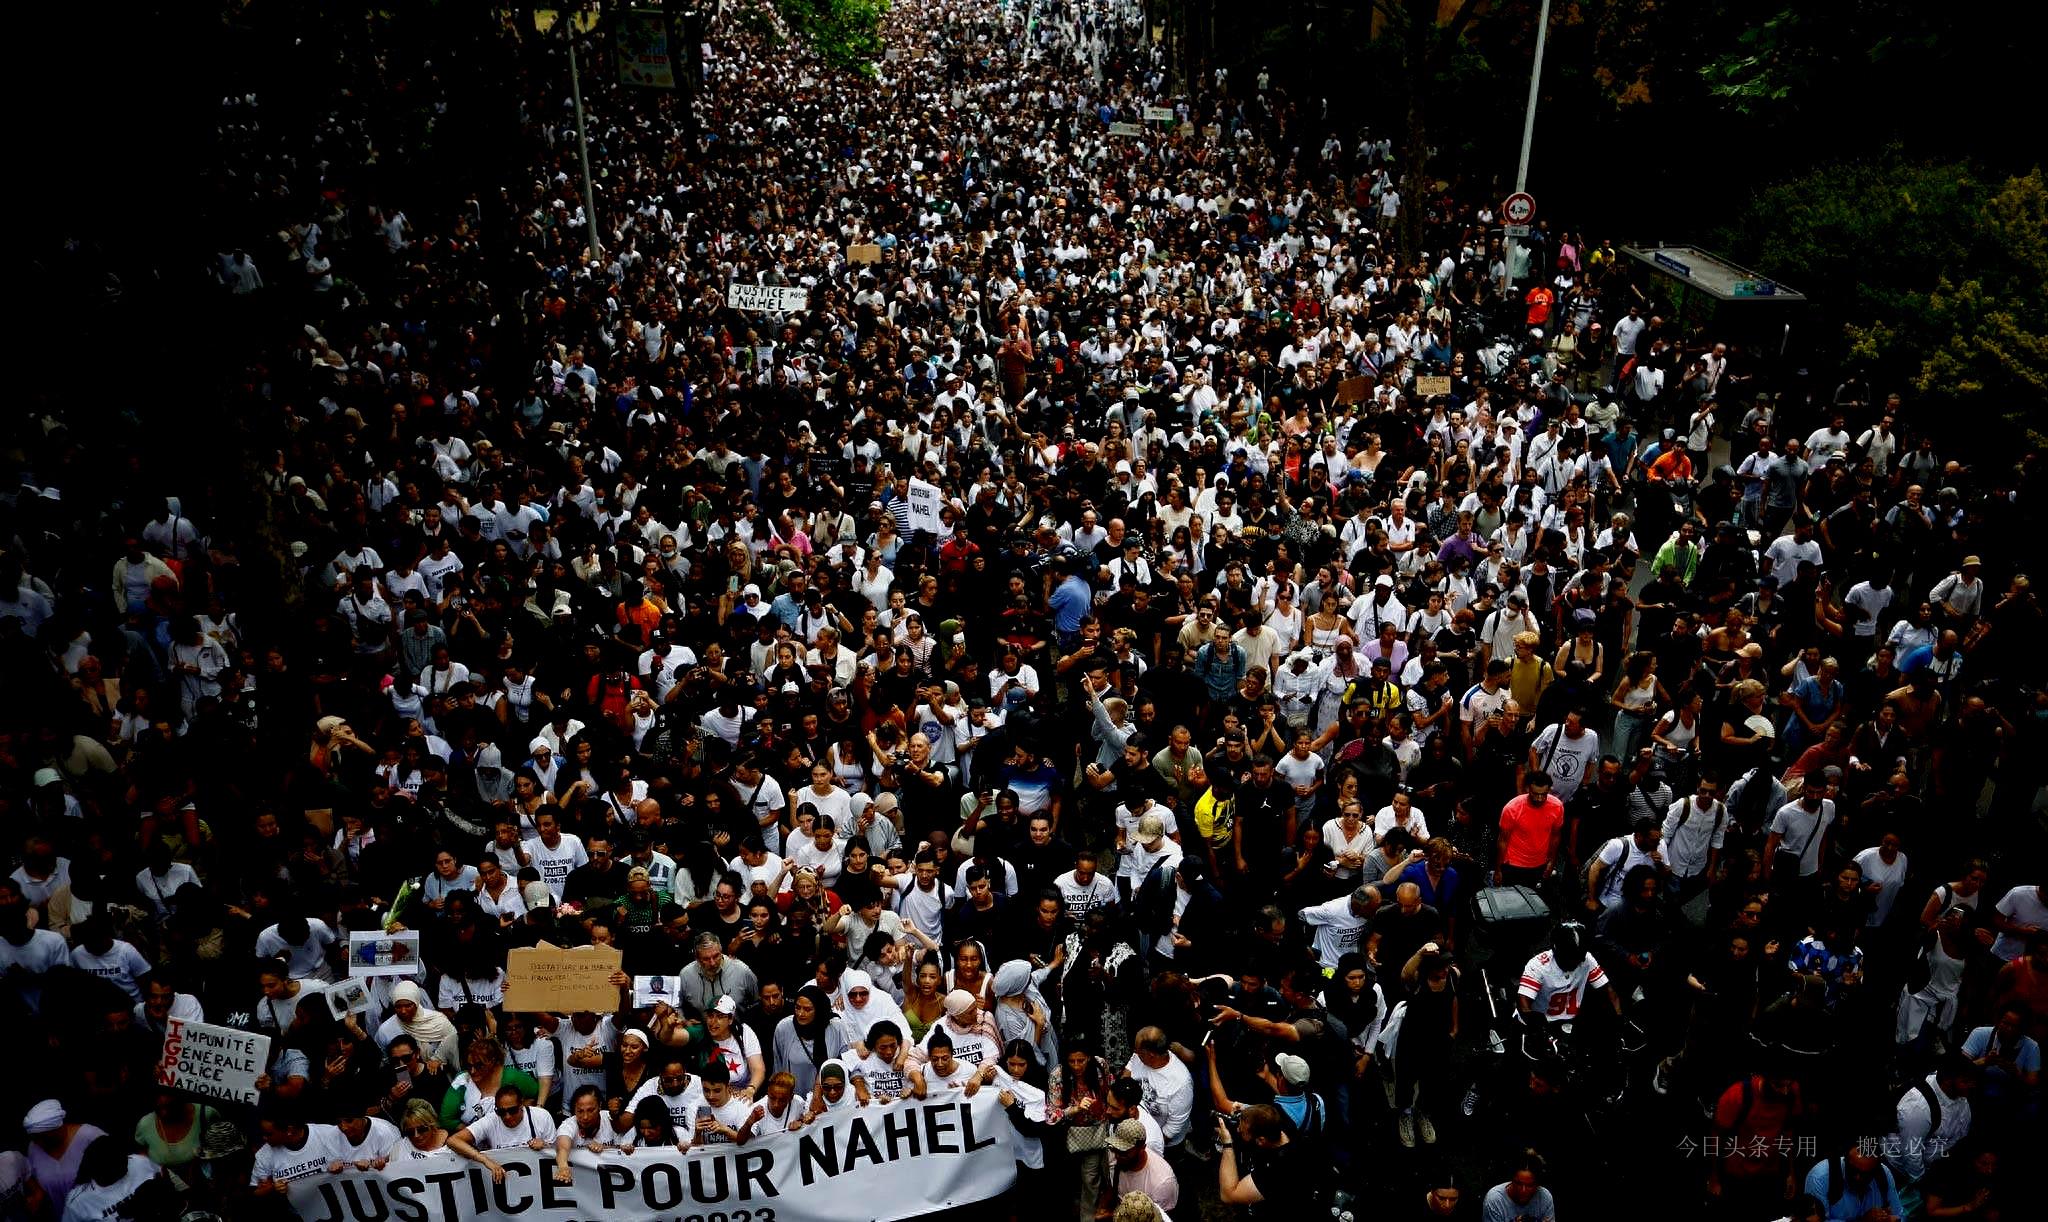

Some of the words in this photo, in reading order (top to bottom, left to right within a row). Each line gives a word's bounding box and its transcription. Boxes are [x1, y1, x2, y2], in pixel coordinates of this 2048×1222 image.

[735, 285, 784, 298] JUSTICE
[738, 296, 784, 311] NAHEL
[912, 502, 930, 516] NAHEL
[1069, 902, 1099, 911] JUSTCE
[1547, 987, 1583, 1016] 91
[168, 1020, 255, 1055] IMPUNITÉ
[164, 1038, 255, 1073] GÉNÉRALE
[164, 1055, 224, 1082] POLICE
[160, 1070, 256, 1104] NATIONALE
[315, 1160, 577, 1222] JUSTICE
[598, 1148, 779, 1210] POUR
[799, 1102, 996, 1185] NAHEL
